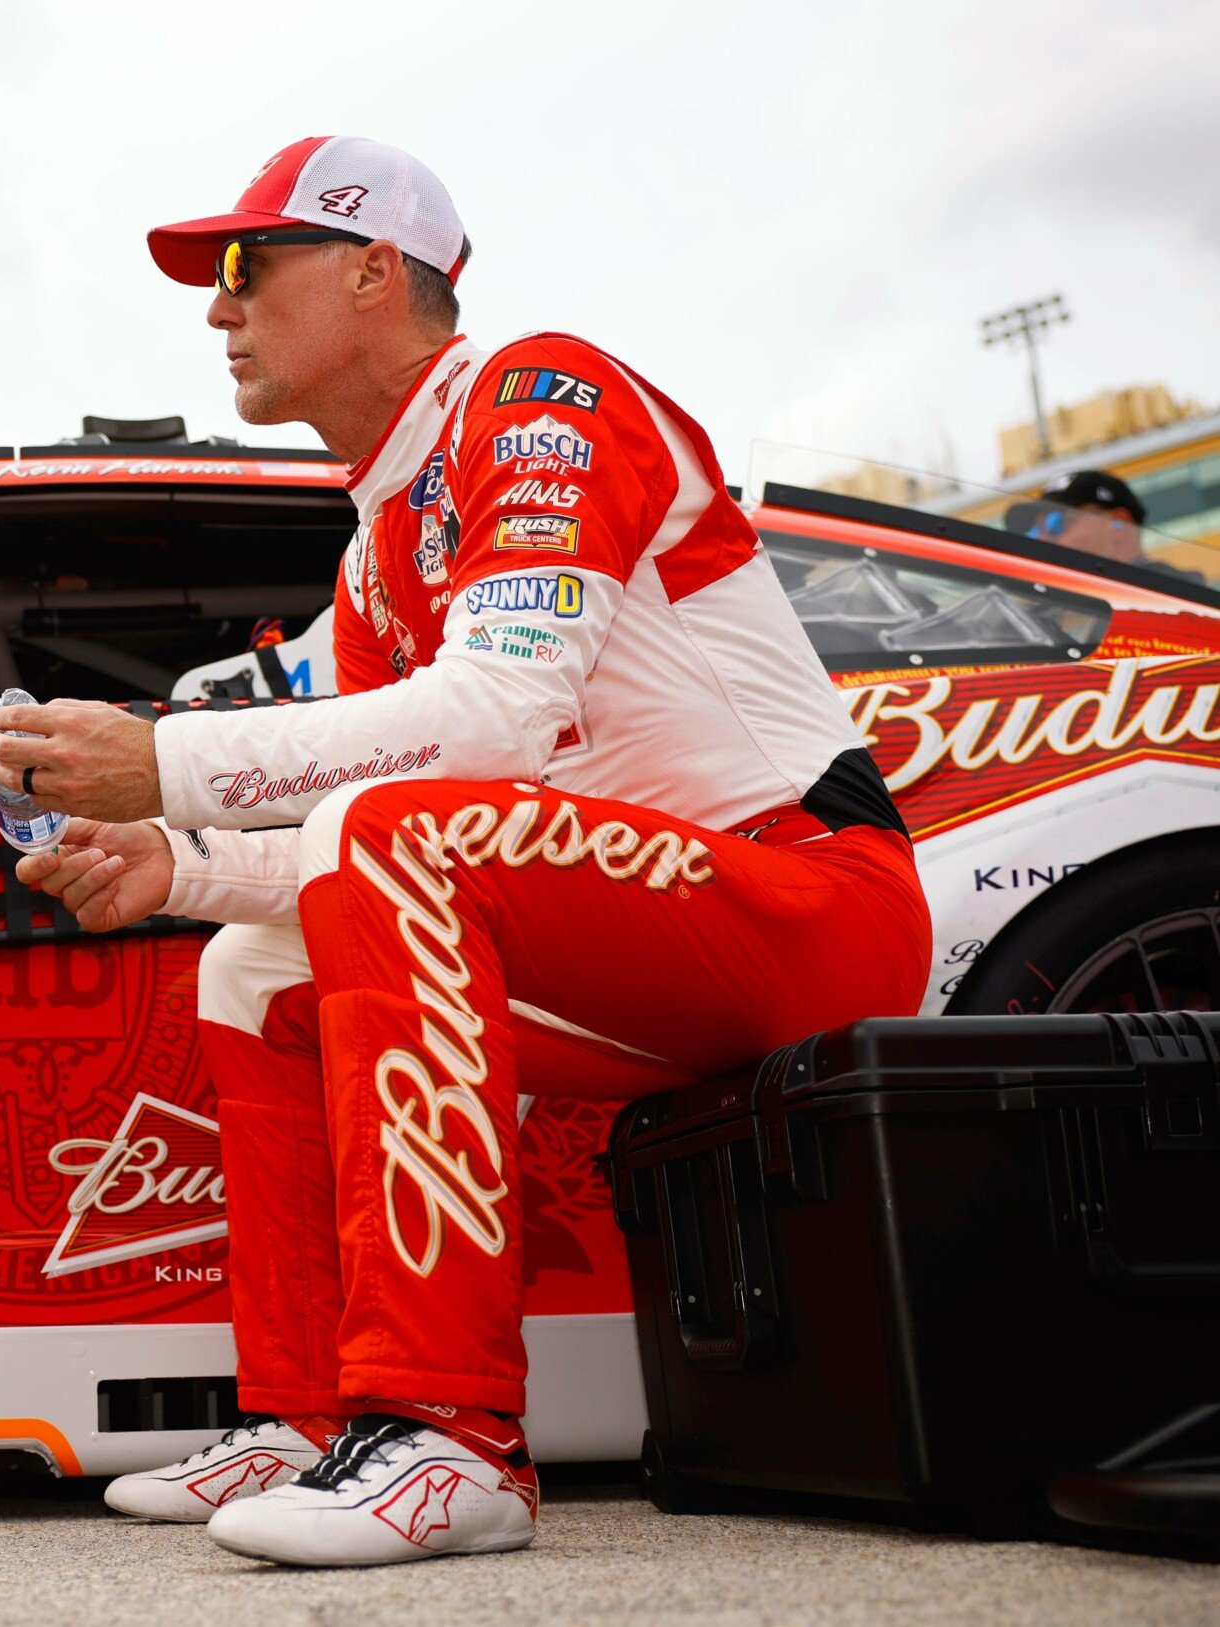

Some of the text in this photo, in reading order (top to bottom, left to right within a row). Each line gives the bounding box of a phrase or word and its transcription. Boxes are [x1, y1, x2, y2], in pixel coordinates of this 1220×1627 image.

[318, 185, 369, 217] 4
[549, 374, 598, 408] 75
[494, 432, 592, 470] BUSCH
[514, 458, 570, 476] LIGHT
[493, 479, 586, 509] HAAS
[510, 535, 563, 545] TRUCK CENTERS
[491, 625, 566, 648] campers
[500, 637, 563, 663] inn RV
[207, 741, 441, 809] Budweiser
[155, 1265, 223, 1282] KING
